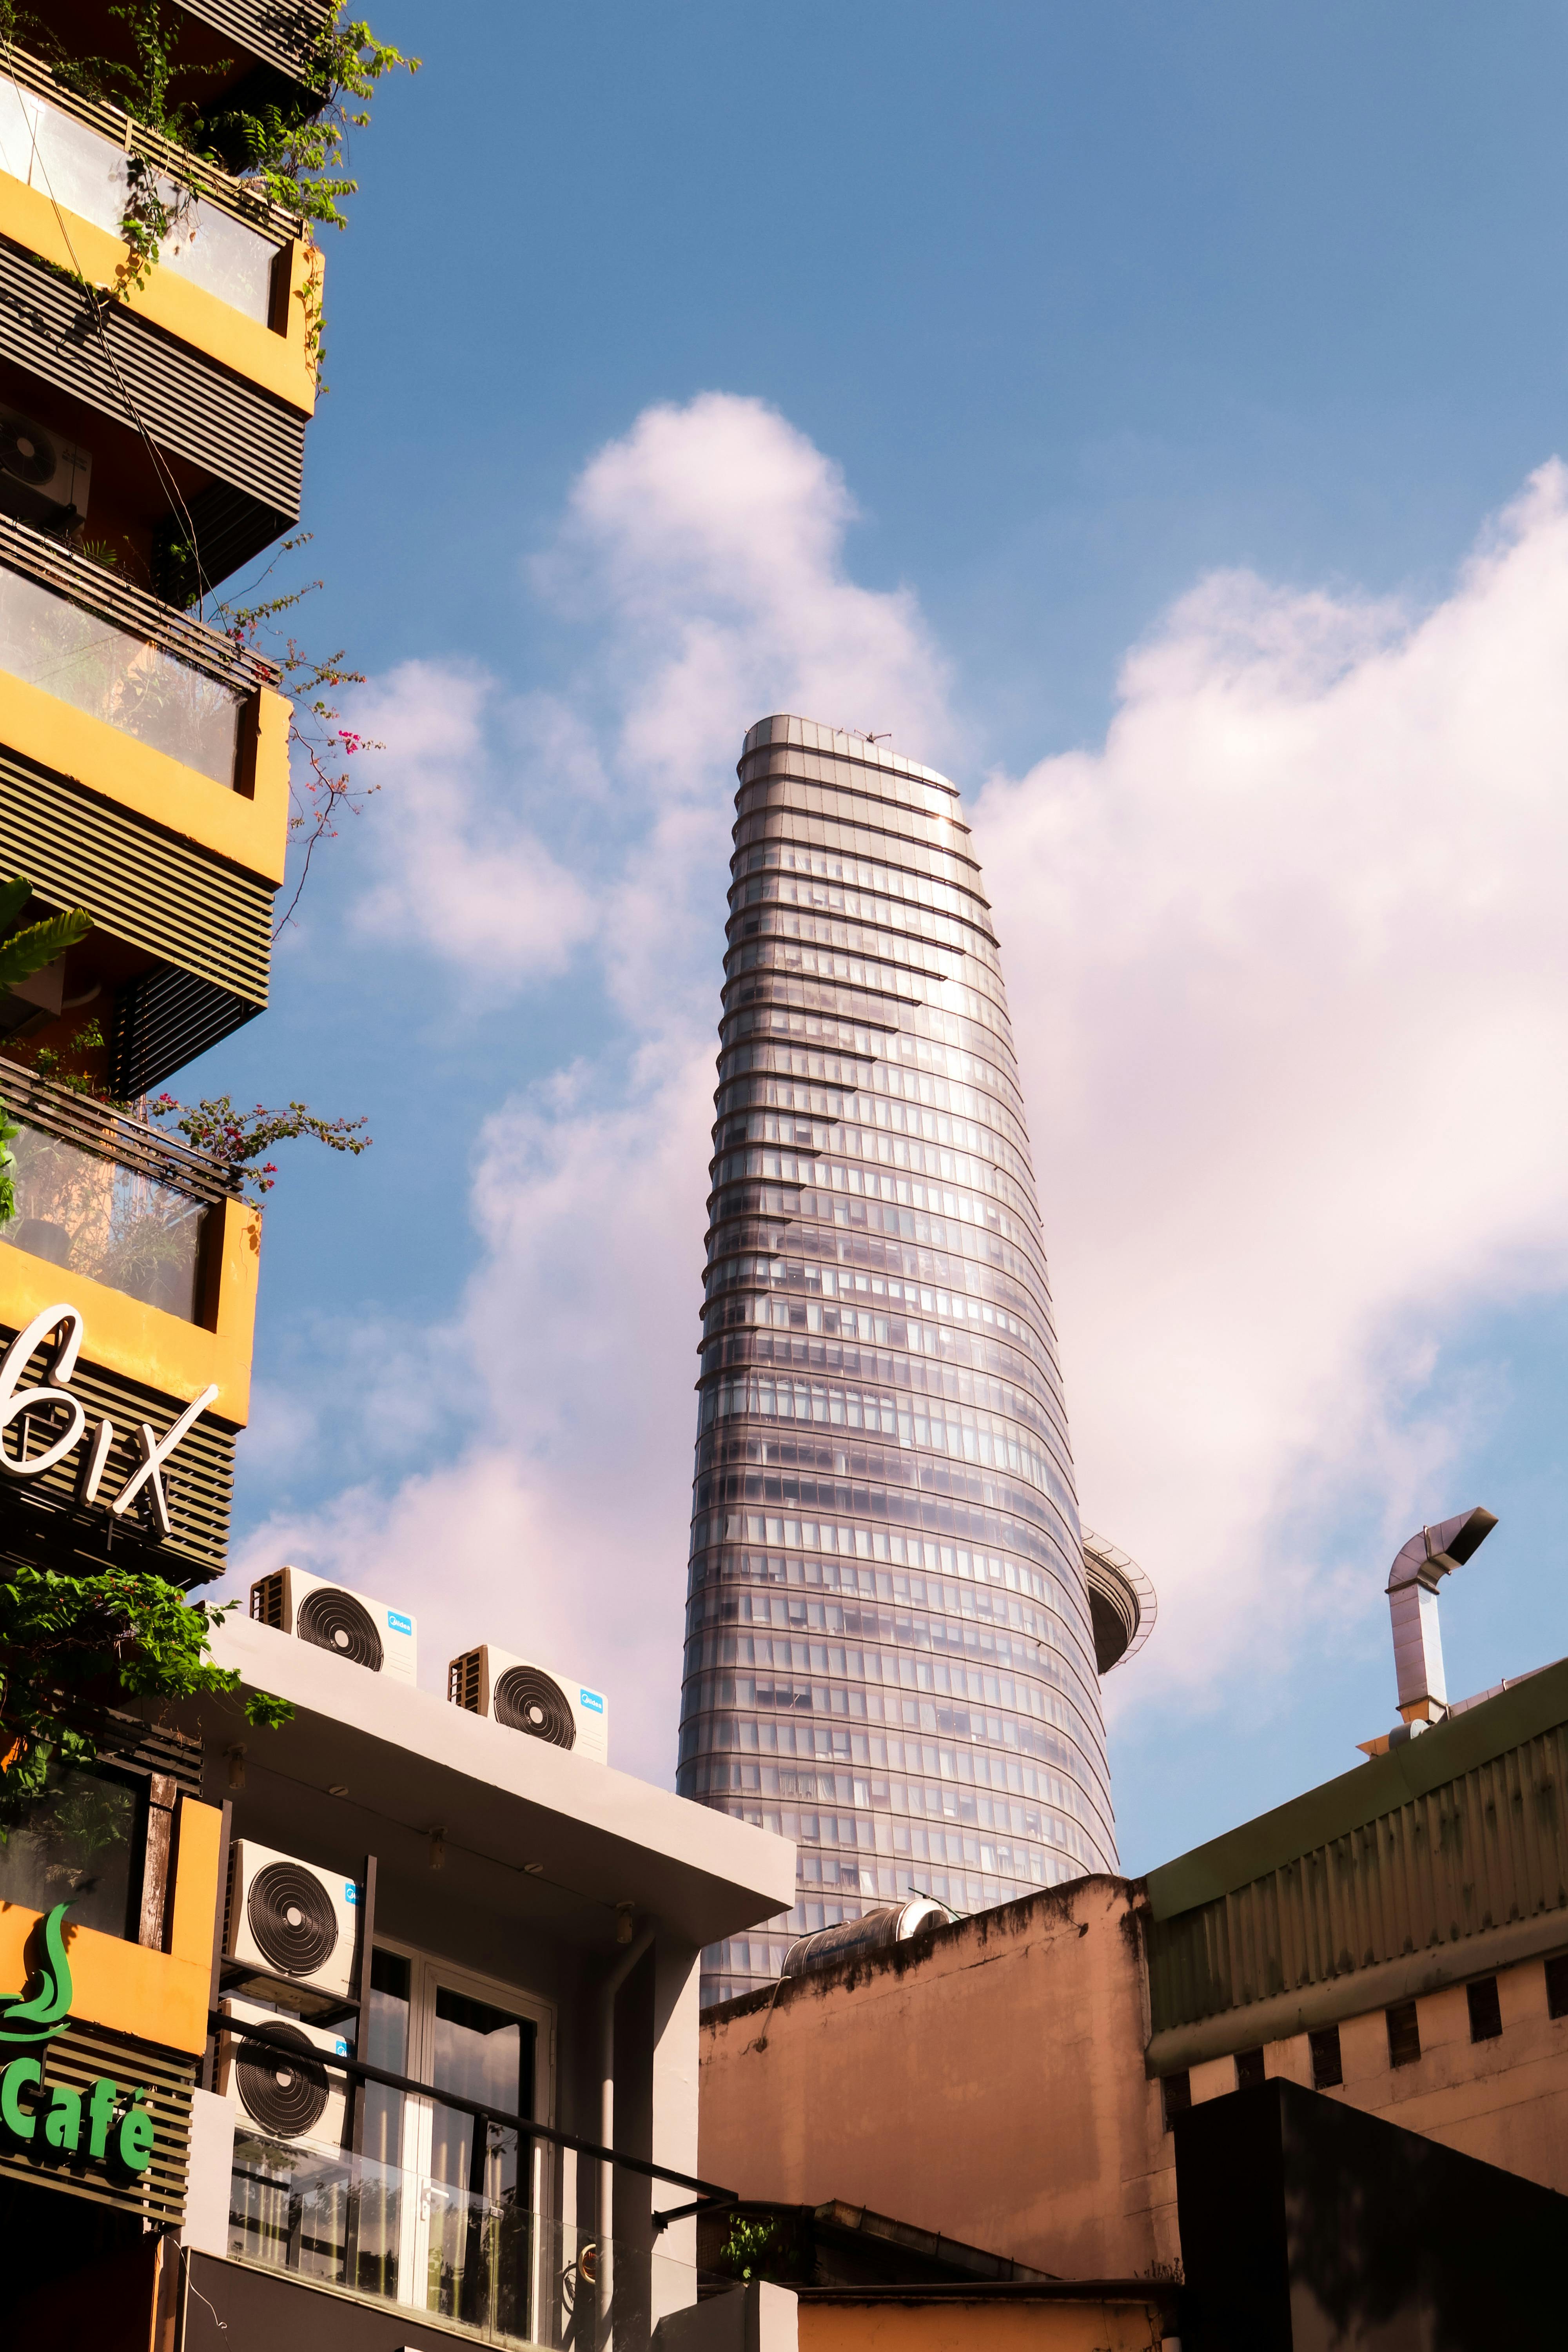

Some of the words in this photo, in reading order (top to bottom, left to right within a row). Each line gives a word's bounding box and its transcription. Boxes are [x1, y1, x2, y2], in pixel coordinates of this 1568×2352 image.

[389, 1616, 410, 1631] Midea
[582, 1693, 602, 1709] Midea
[1, 2058, 154, 2171] Café
